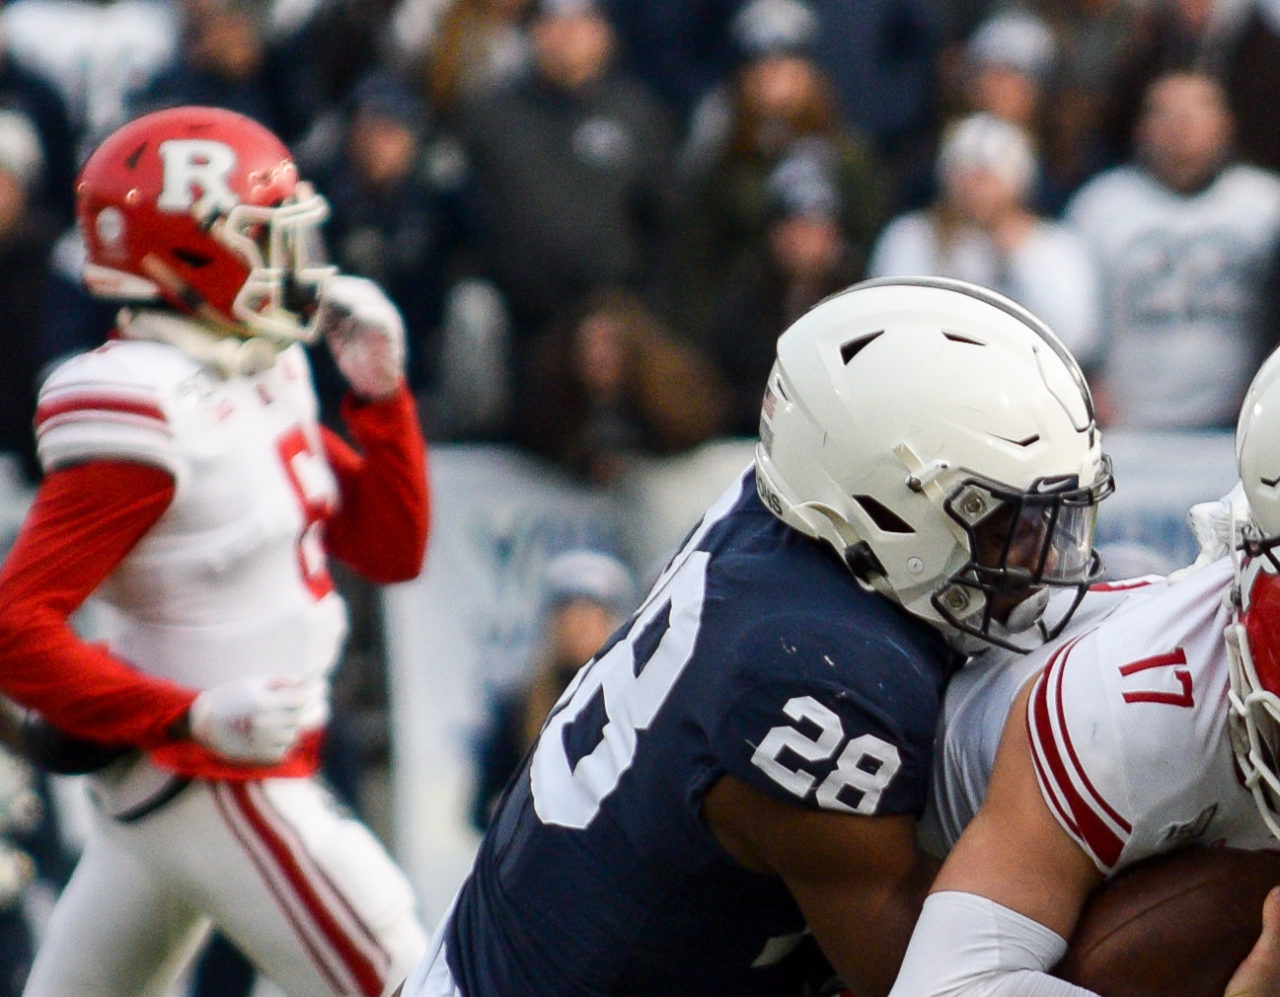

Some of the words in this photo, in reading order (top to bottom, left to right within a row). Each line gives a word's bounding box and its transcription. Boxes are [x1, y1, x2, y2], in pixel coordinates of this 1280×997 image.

[157, 139, 240, 214] R
[1119, 647, 1195, 708] 17
[750, 695, 901, 815] 28
